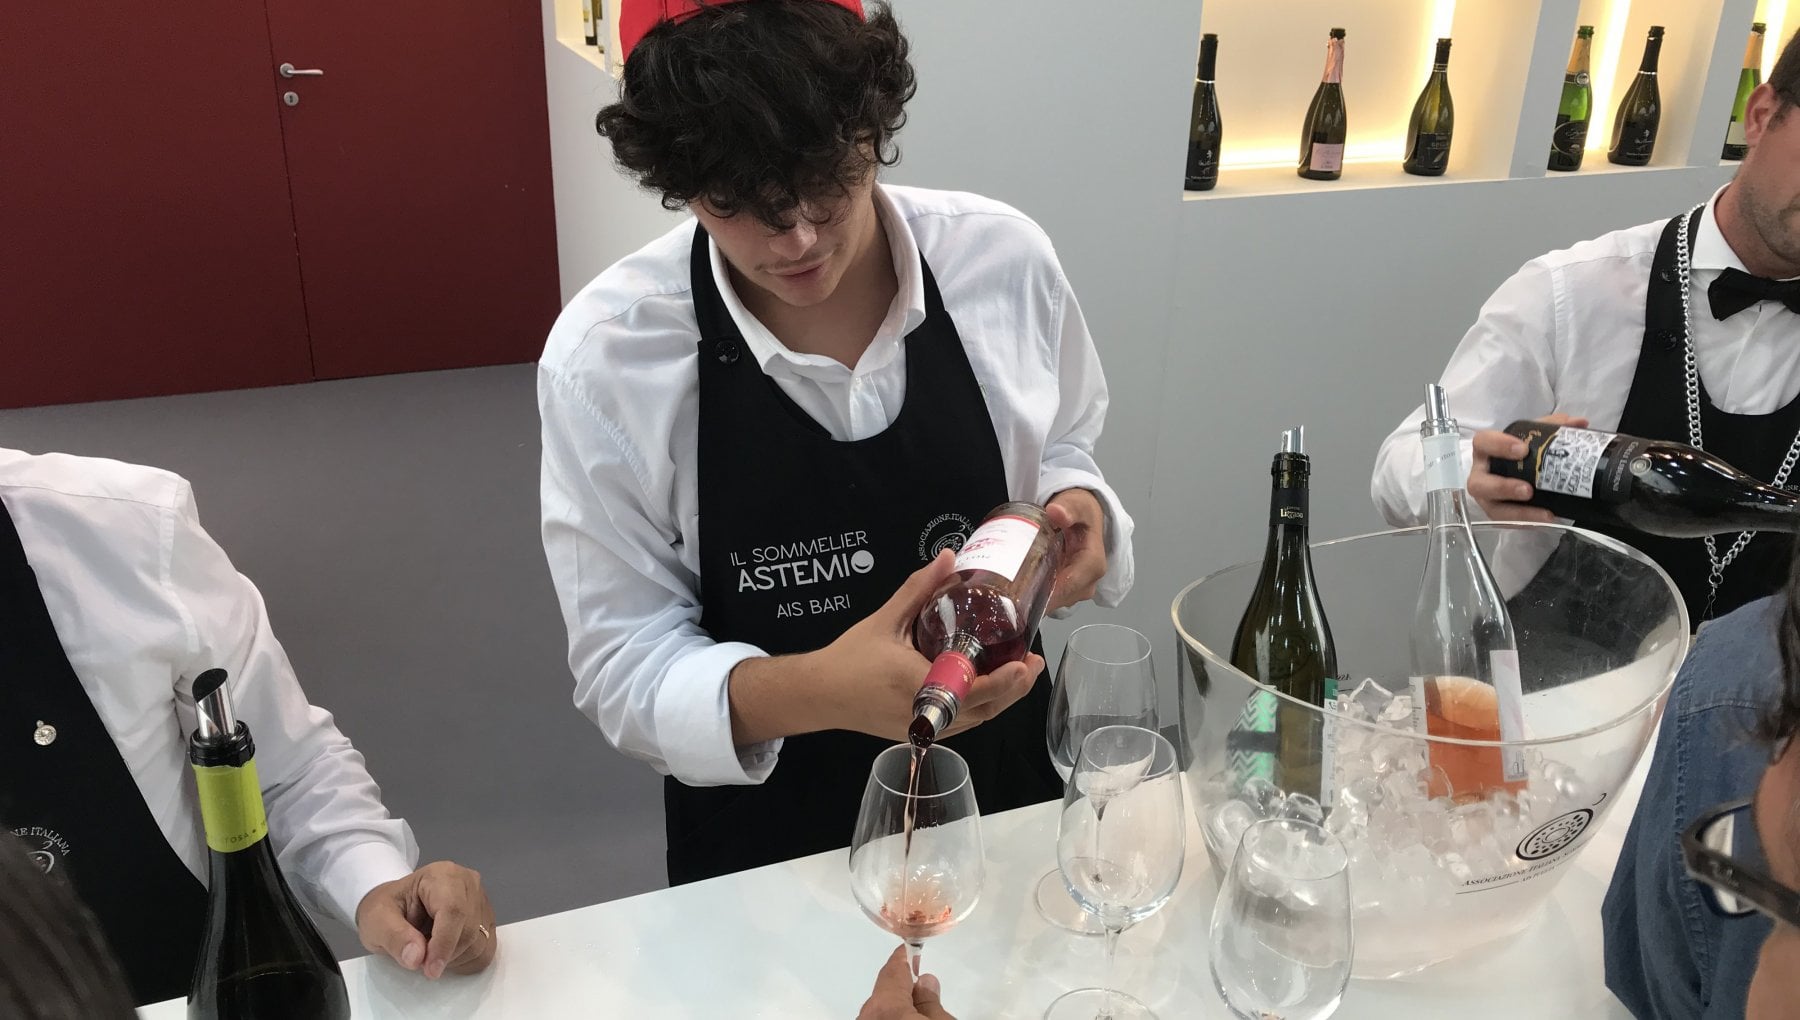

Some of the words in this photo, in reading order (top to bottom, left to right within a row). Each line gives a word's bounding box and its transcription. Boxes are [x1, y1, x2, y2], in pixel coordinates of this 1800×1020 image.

[730, 552, 746, 566] IL
[752, 530, 868, 562] SOMMELIER
[918, 513, 950, 561] ASSOCIAZIONE
[738, 550, 875, 593] ASTEMIO
[777, 601, 804, 619] AIS
[809, 593, 851, 614] BARI
[30, 826, 71, 857] ITALIANA
